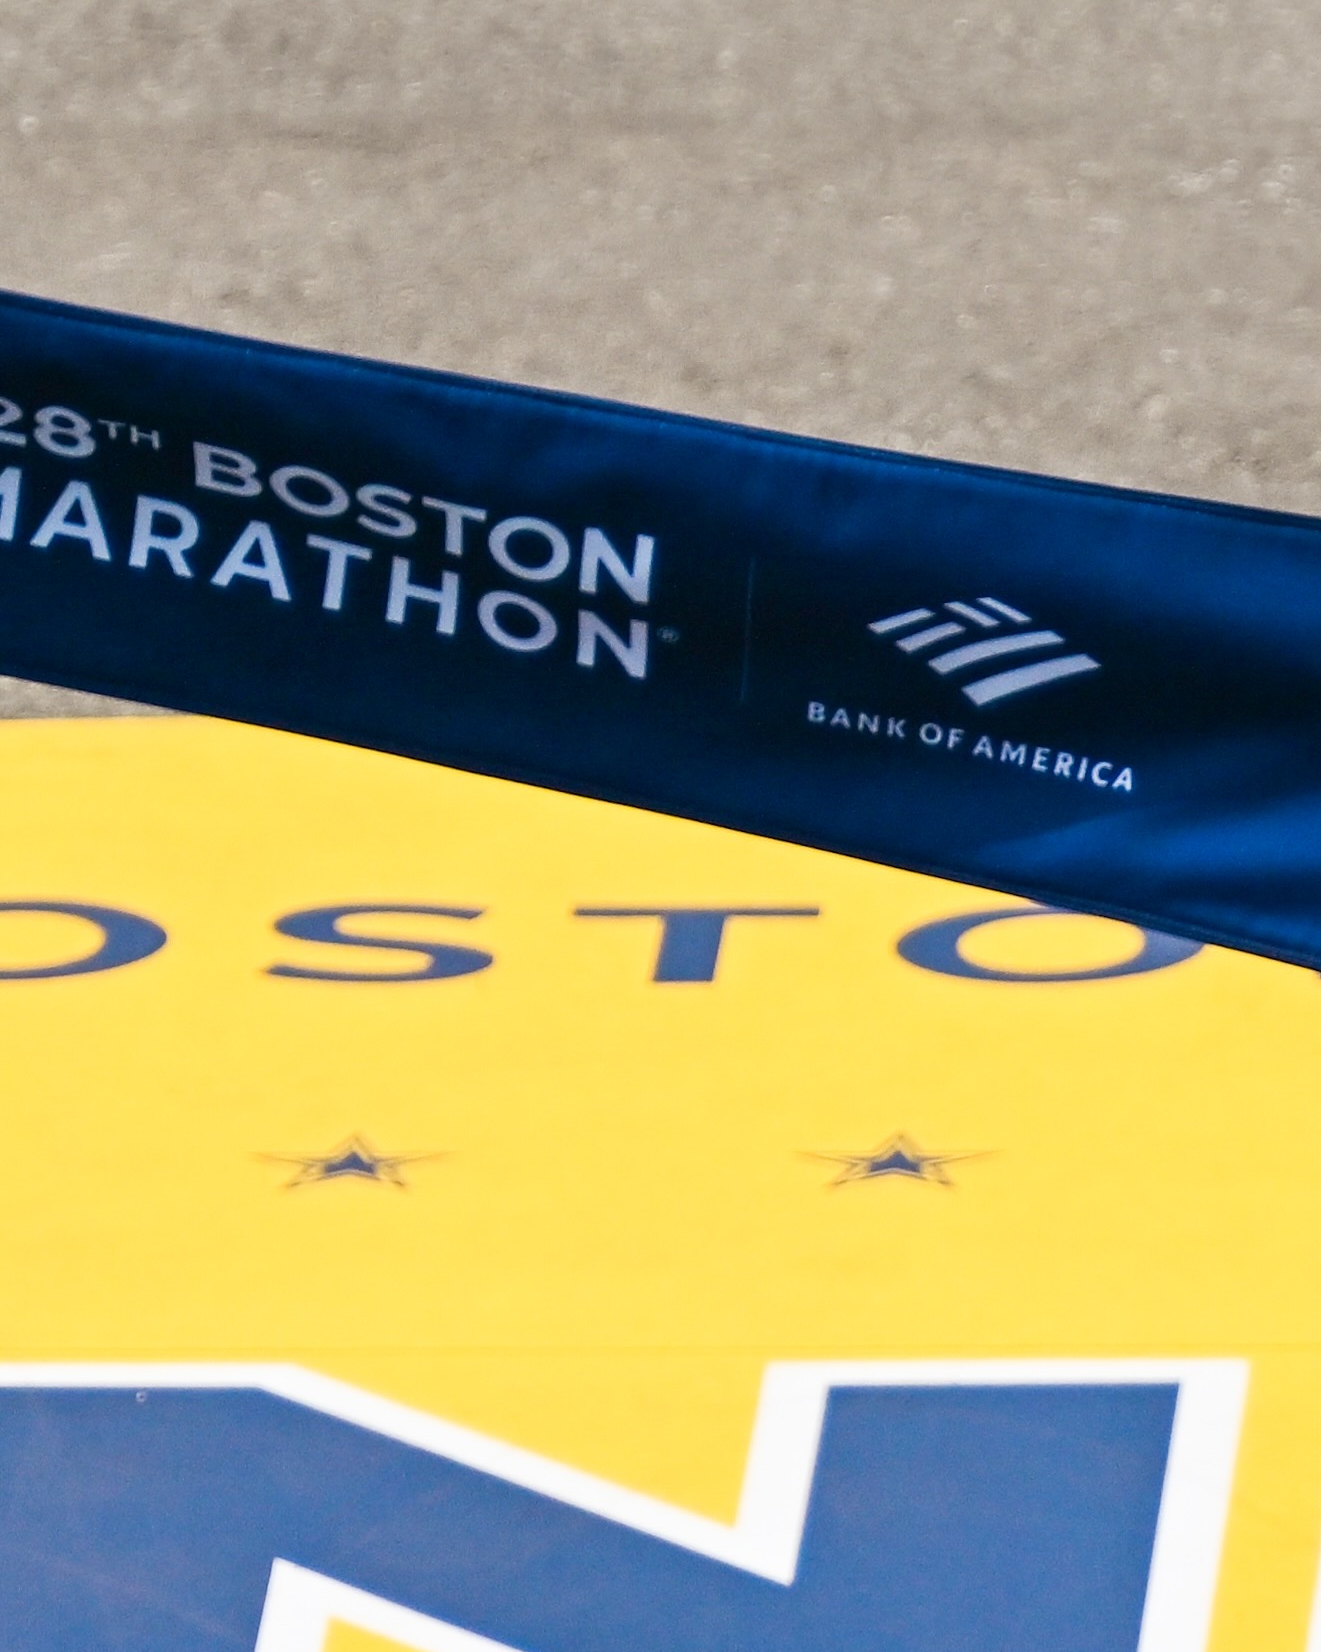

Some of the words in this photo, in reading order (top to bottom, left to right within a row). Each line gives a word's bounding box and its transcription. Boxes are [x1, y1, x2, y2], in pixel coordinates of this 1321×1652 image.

[0, 465, 649, 680] ARATHON
[193, 441, 656, 605] BOSTON
[807, 700, 906, 738] BANK
[919, 721, 965, 750] OF
[972, 734, 1134, 793] AMERICA
